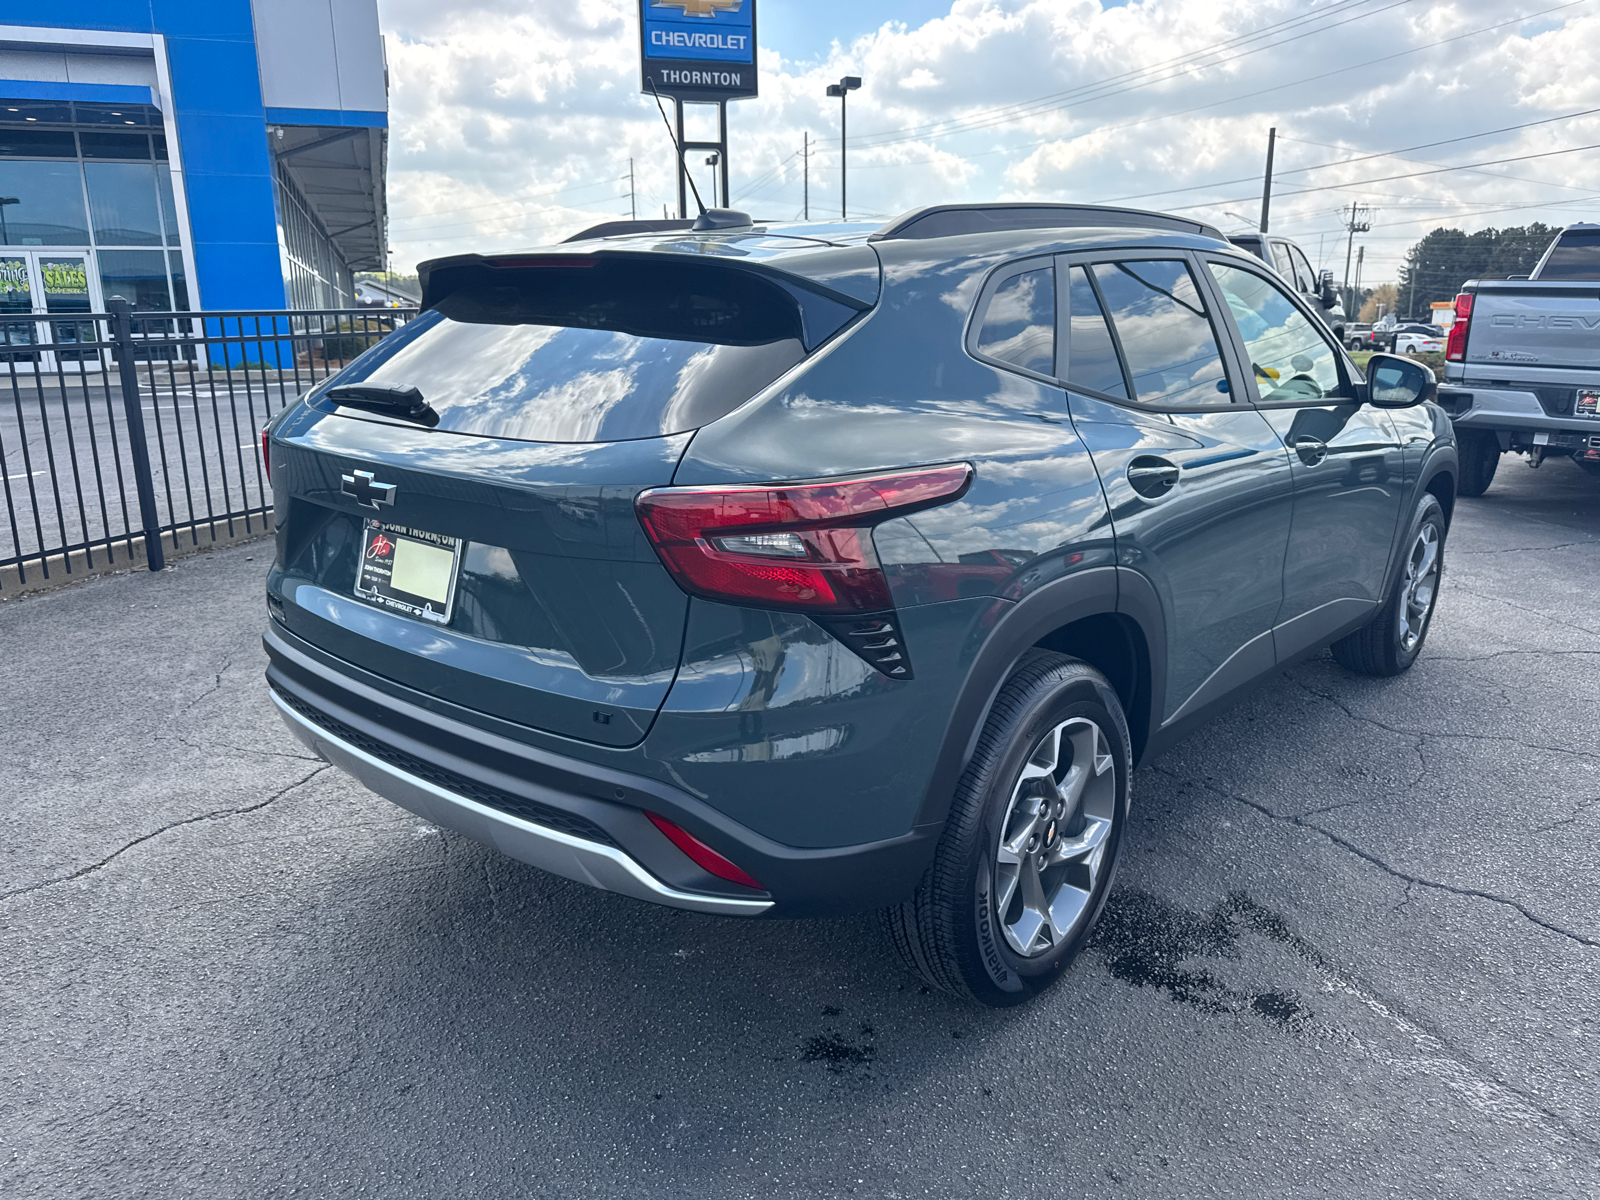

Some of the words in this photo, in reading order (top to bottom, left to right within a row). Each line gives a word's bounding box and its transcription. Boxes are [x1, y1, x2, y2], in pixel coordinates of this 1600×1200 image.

[651, 31, 747, 50] CHEVROLET
[660, 69, 741, 86] THORNTON
[45, 270, 86, 288] SALES
[385, 599, 413, 613] CHEVROLET
[593, 710, 614, 725] LT
